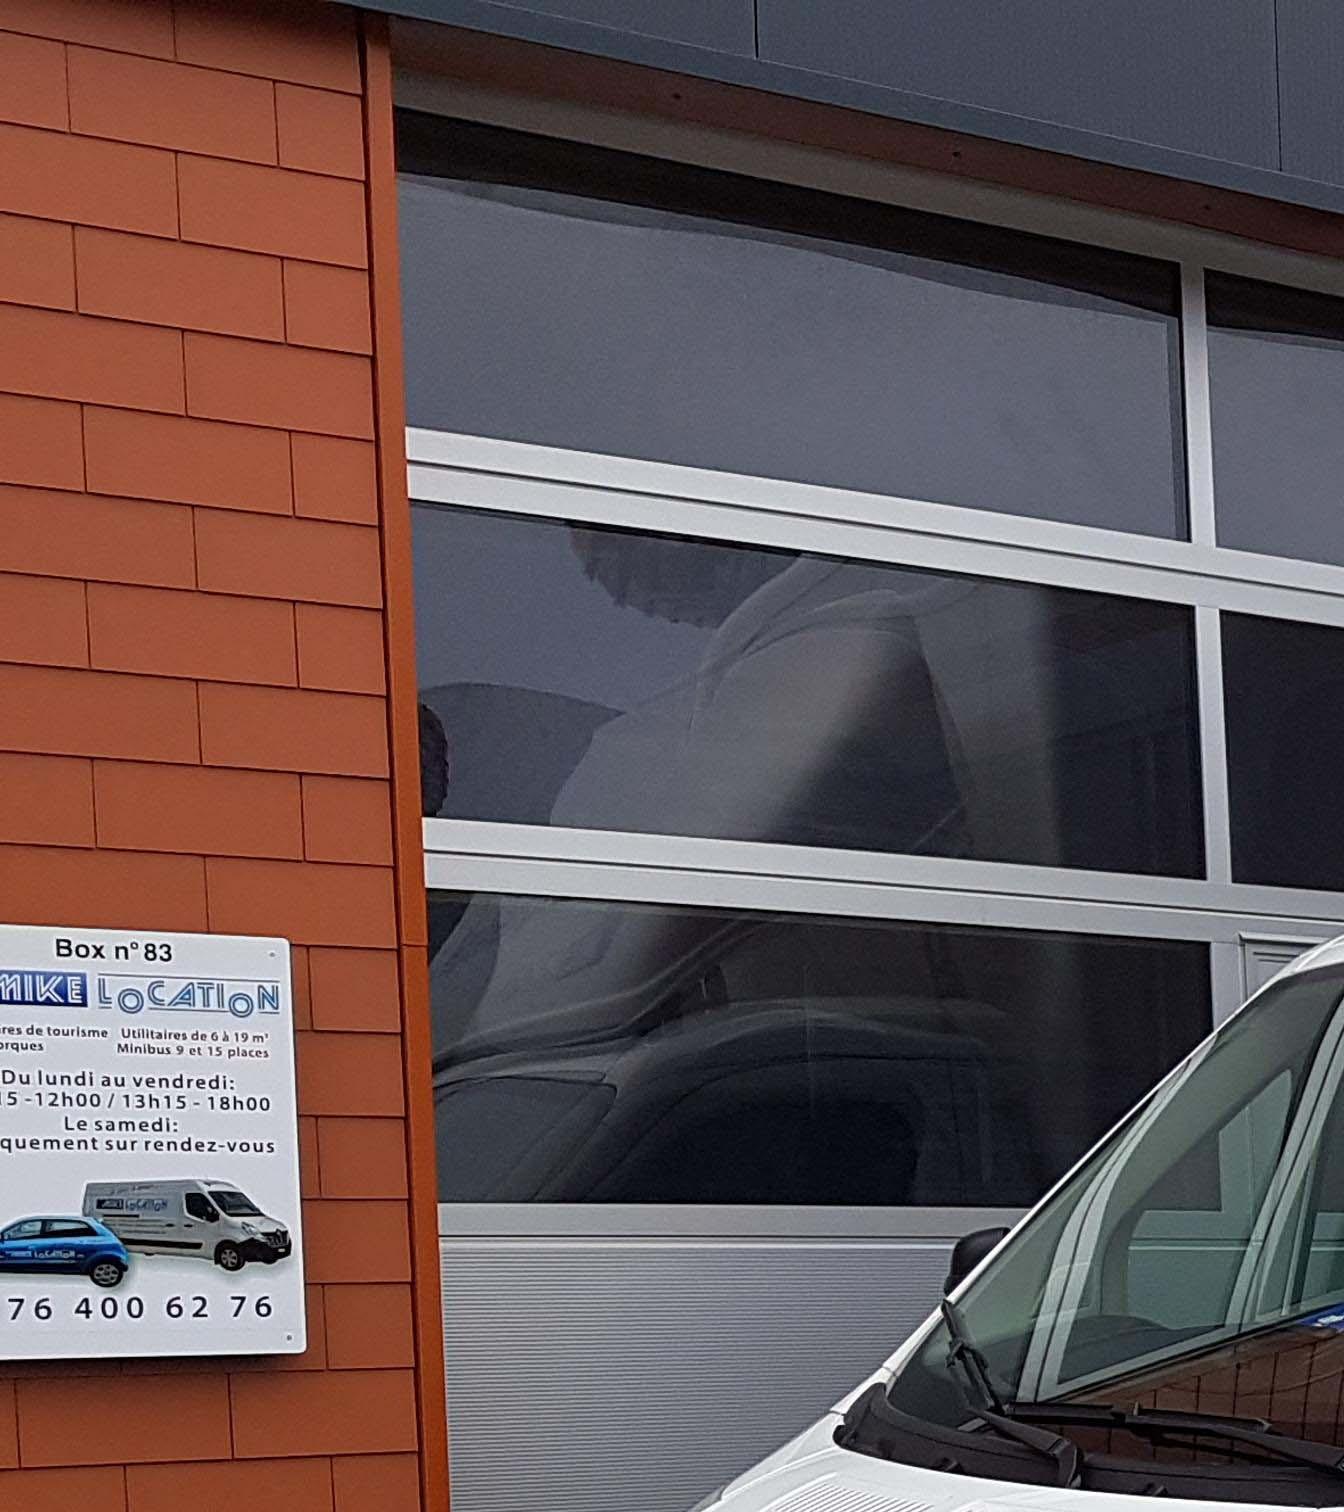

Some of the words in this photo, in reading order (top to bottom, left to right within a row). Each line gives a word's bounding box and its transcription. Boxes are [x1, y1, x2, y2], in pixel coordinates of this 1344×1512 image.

[55, 938, 106, 959] Box
[0, 973, 83, 1004] MIKE
[98, 975, 280, 1018] LOCATION
[0, 1026, 22, 1036] res
[26, 1024, 43, 1036] de
[47, 1026, 109, 1038] tourisme
[121, 1028, 187, 1042] Utilitaires
[191, 1030, 208, 1042] de
[211, 1031, 219, 1042] 6
[222, 1030, 230, 1042] à
[234, 1032, 249, 1043] 19
[117, 1043, 172, 1056] Minibus
[176, 1045, 184, 1056] 9
[189, 1046, 203, 1056] et
[207, 1046, 223, 1057] 15
[227, 1046, 270, 1059] places
[2, 1069, 30, 1085] Du
[38, 1070, 94, 1086] lundi
[101, 1075, 125, 1087] au
[133, 1073, 235, 1090] vendredi:
[123, 1094, 187, 1110] 13h15
[208, 1096, 271, 1112] 18h00
[65, 1116, 88, 1131] Le
[95, 1117, 178, 1133] samedi:
[0, 1137, 98, 1153] quement
[105, 1139, 138, 1151] sur
[144, 1137, 275, 1153] rendez-vous
[74, 1297, 144, 1319] 400
[166, 1296, 208, 1318] 62
[230, 1295, 272, 1317] 76
